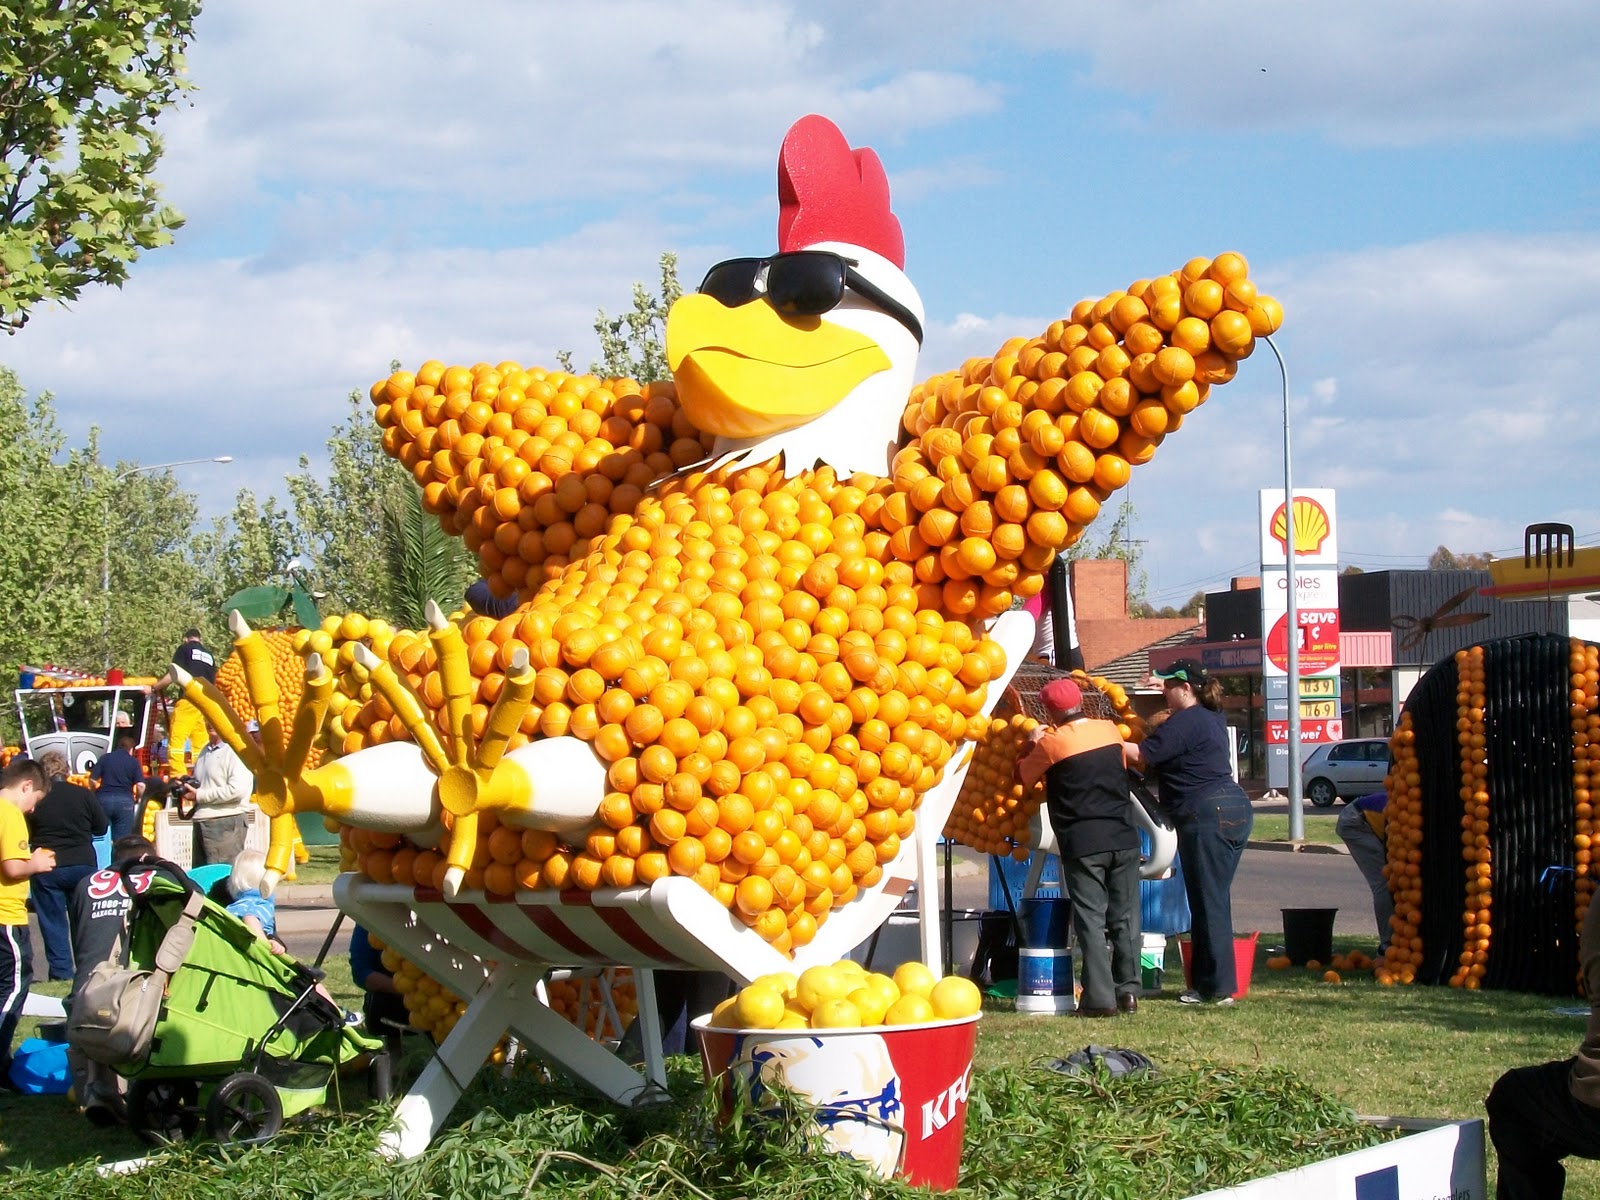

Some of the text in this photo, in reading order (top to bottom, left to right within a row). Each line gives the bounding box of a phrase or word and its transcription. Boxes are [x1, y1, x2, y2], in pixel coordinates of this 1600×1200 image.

[1277, 576, 1320, 589] cles
[1300, 612, 1336, 624] save
[1272, 730, 1320, 739] V-wer
[921, 1059, 972, 1141] KFC
